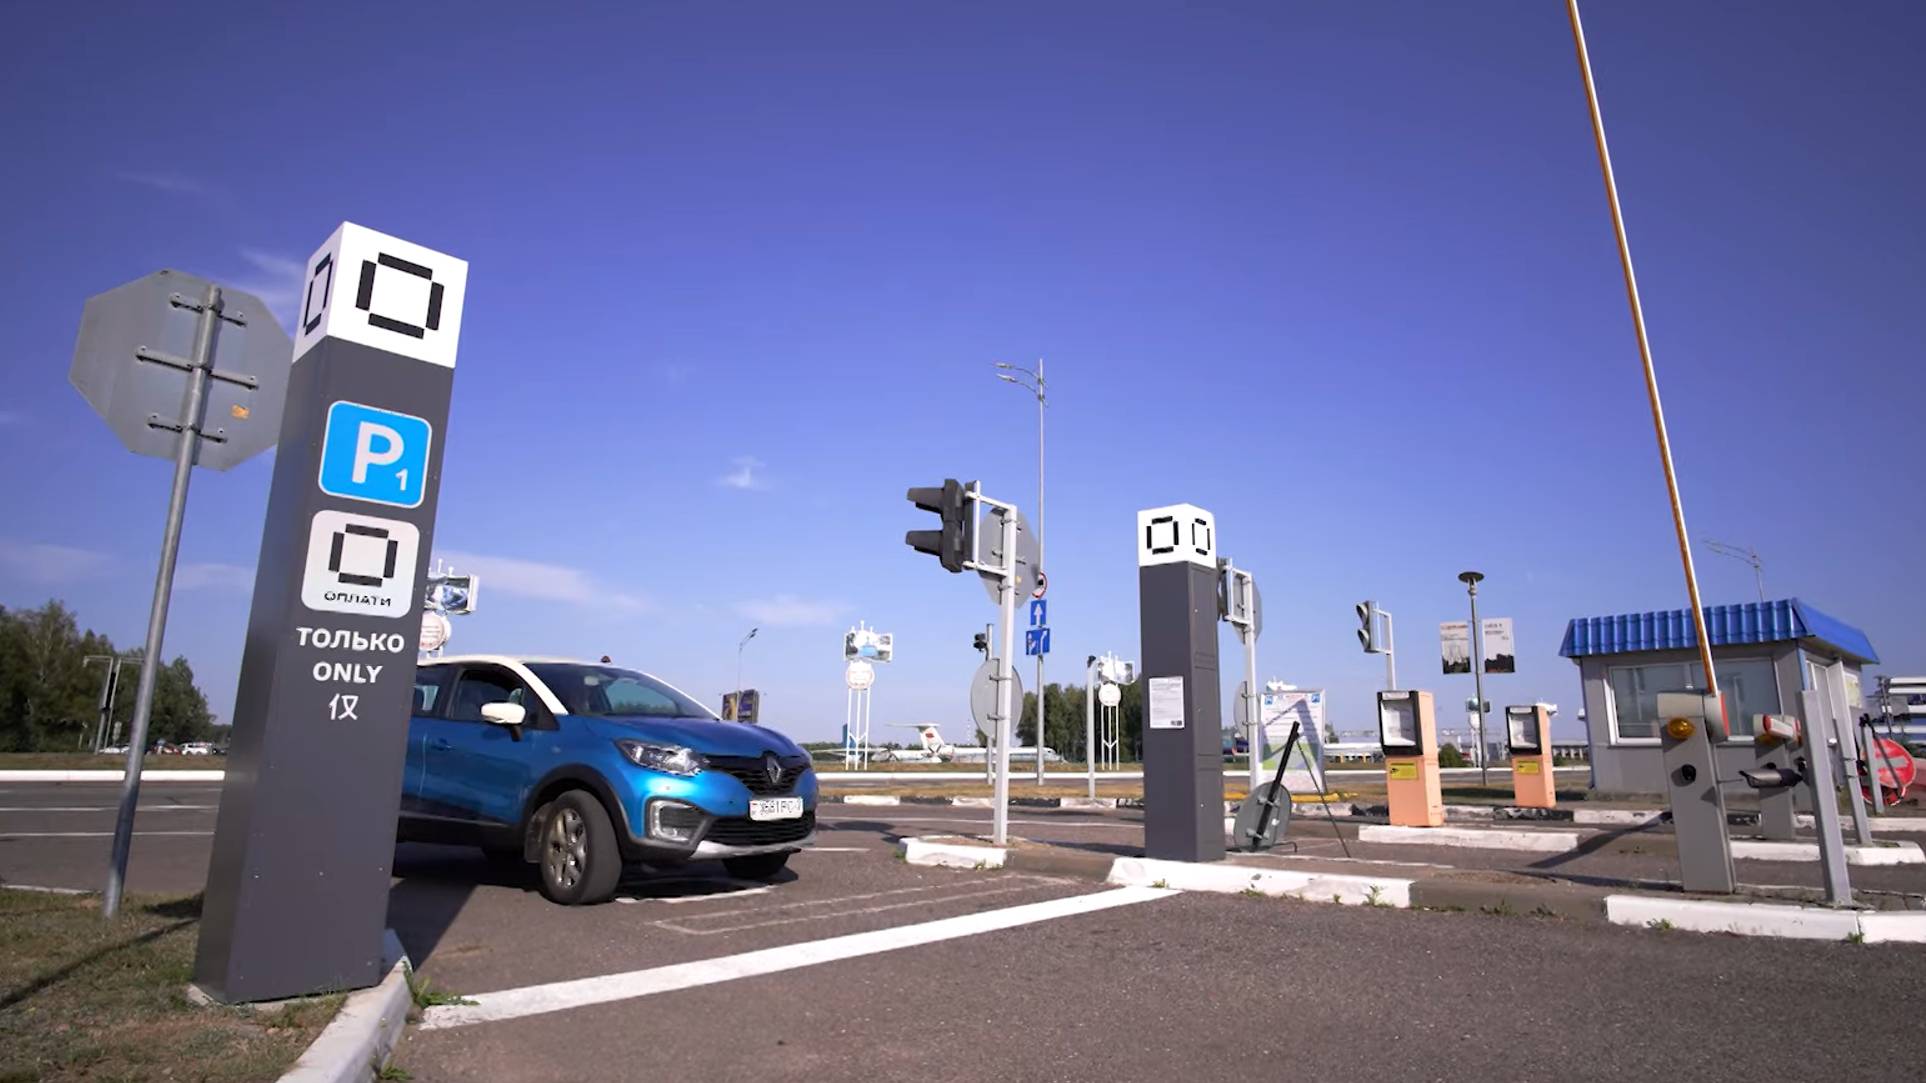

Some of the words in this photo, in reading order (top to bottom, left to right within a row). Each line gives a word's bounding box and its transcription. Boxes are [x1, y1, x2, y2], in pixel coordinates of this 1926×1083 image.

[324, 590, 392, 608] ОПЛАТИ
[297, 627, 404, 653] ТОЛЬКО
[313, 662, 383, 683] ONLY
[329, 693, 359, 721] 仅
